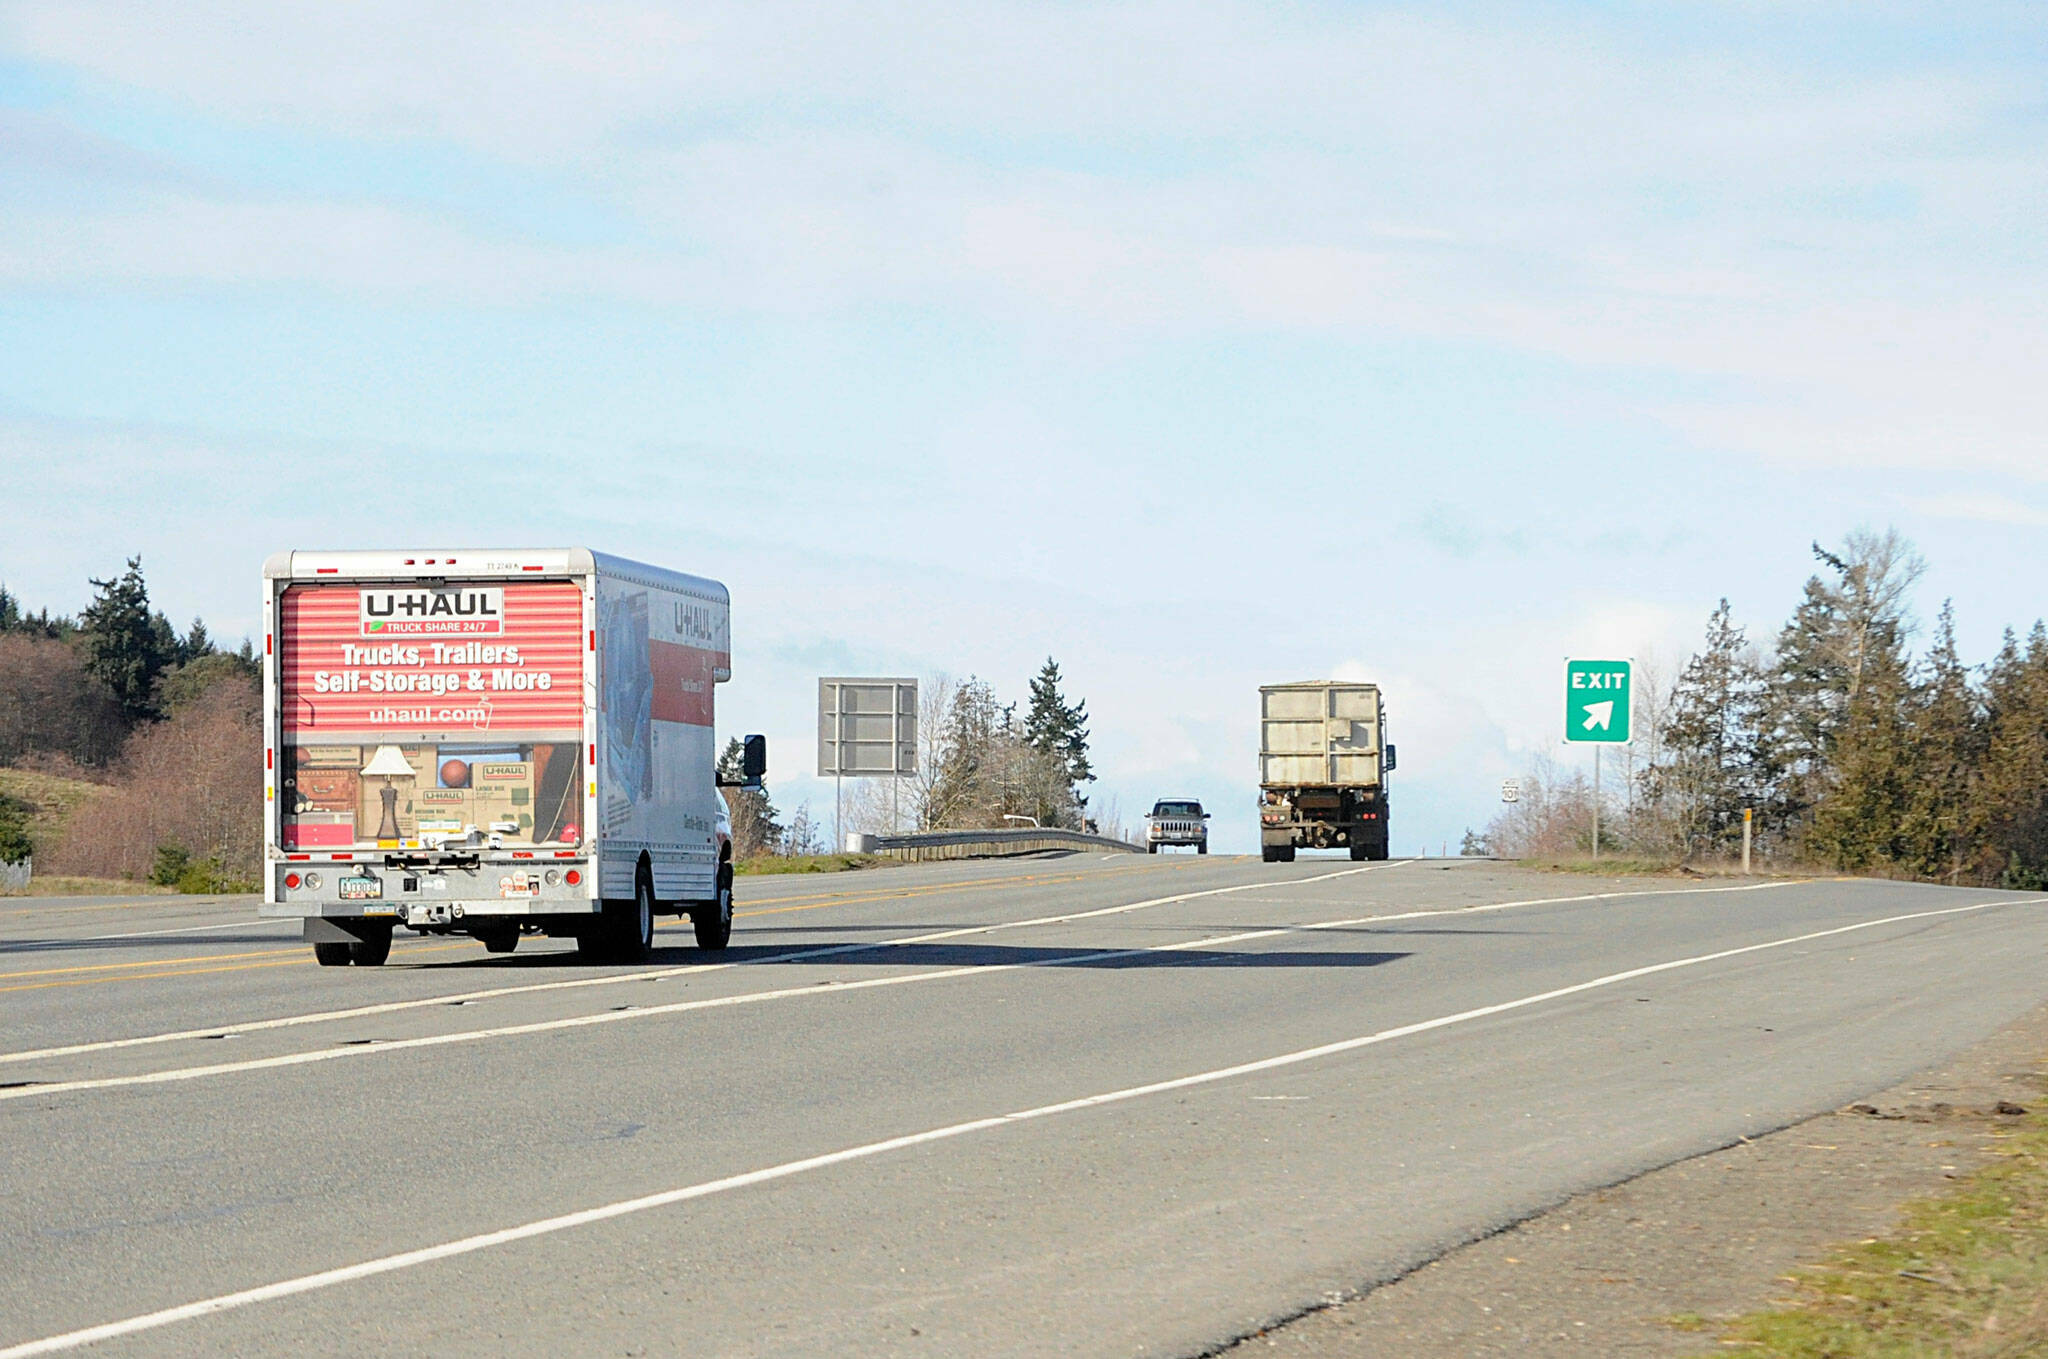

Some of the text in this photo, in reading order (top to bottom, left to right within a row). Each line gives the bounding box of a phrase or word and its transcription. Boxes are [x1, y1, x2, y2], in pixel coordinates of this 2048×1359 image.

[367, 594, 497, 616] U-HAUL
[387, 622, 486, 633] TRUCK SHARE 24/7
[674, 602, 713, 641] U-HAUL
[340, 642, 525, 668] Trucks, Trailers,
[313, 671, 553, 697] Self-Storage & More
[1571, 672, 1626, 689] EXIT
[369, 705, 487, 724] uhaul.com
